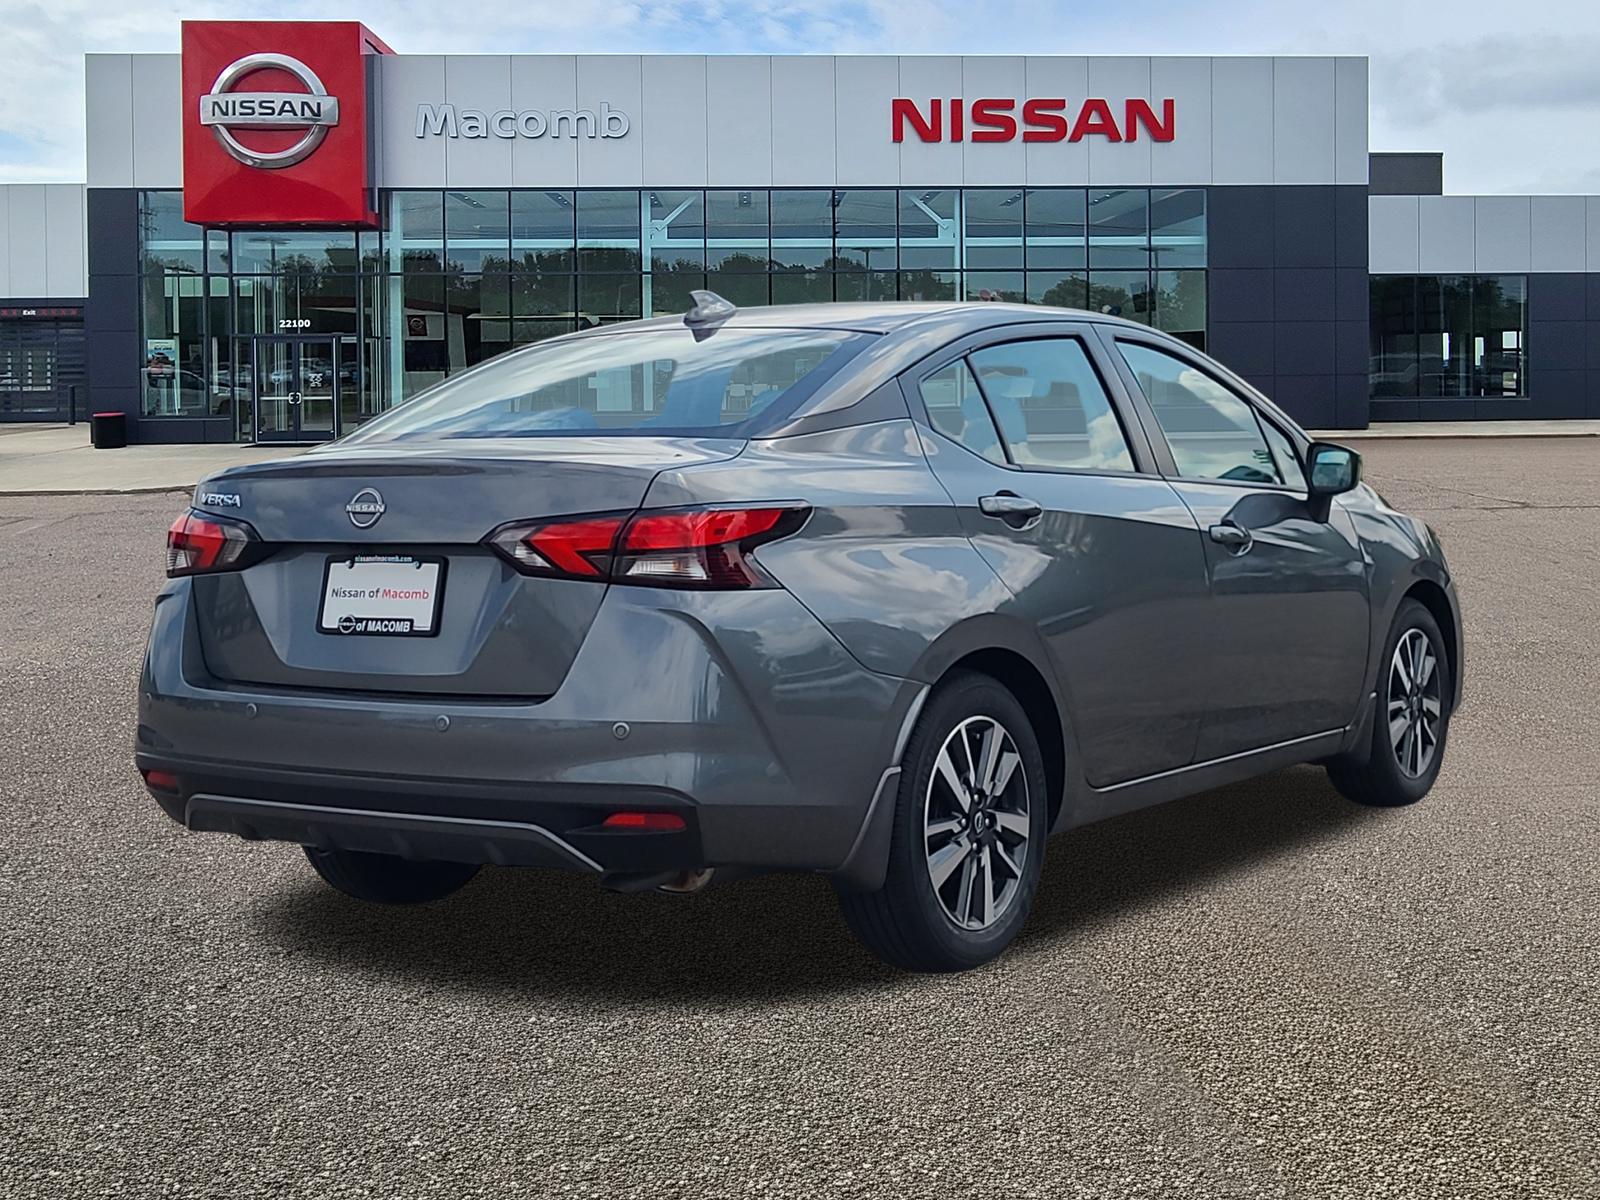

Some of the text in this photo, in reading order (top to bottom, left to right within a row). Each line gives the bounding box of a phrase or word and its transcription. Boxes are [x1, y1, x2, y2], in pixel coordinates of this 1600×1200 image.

[211, 99, 322, 118] NISSAN
[415, 101, 631, 139] Macomb
[891, 98, 1175, 143] NISSAN
[279, 319, 311, 328] 22100
[201, 493, 241, 508] VERSA
[346, 504, 386, 513] NISSAN
[331, 587, 430, 600] Nissan of Macomb
[355, 620, 411, 633] of MACOMB
